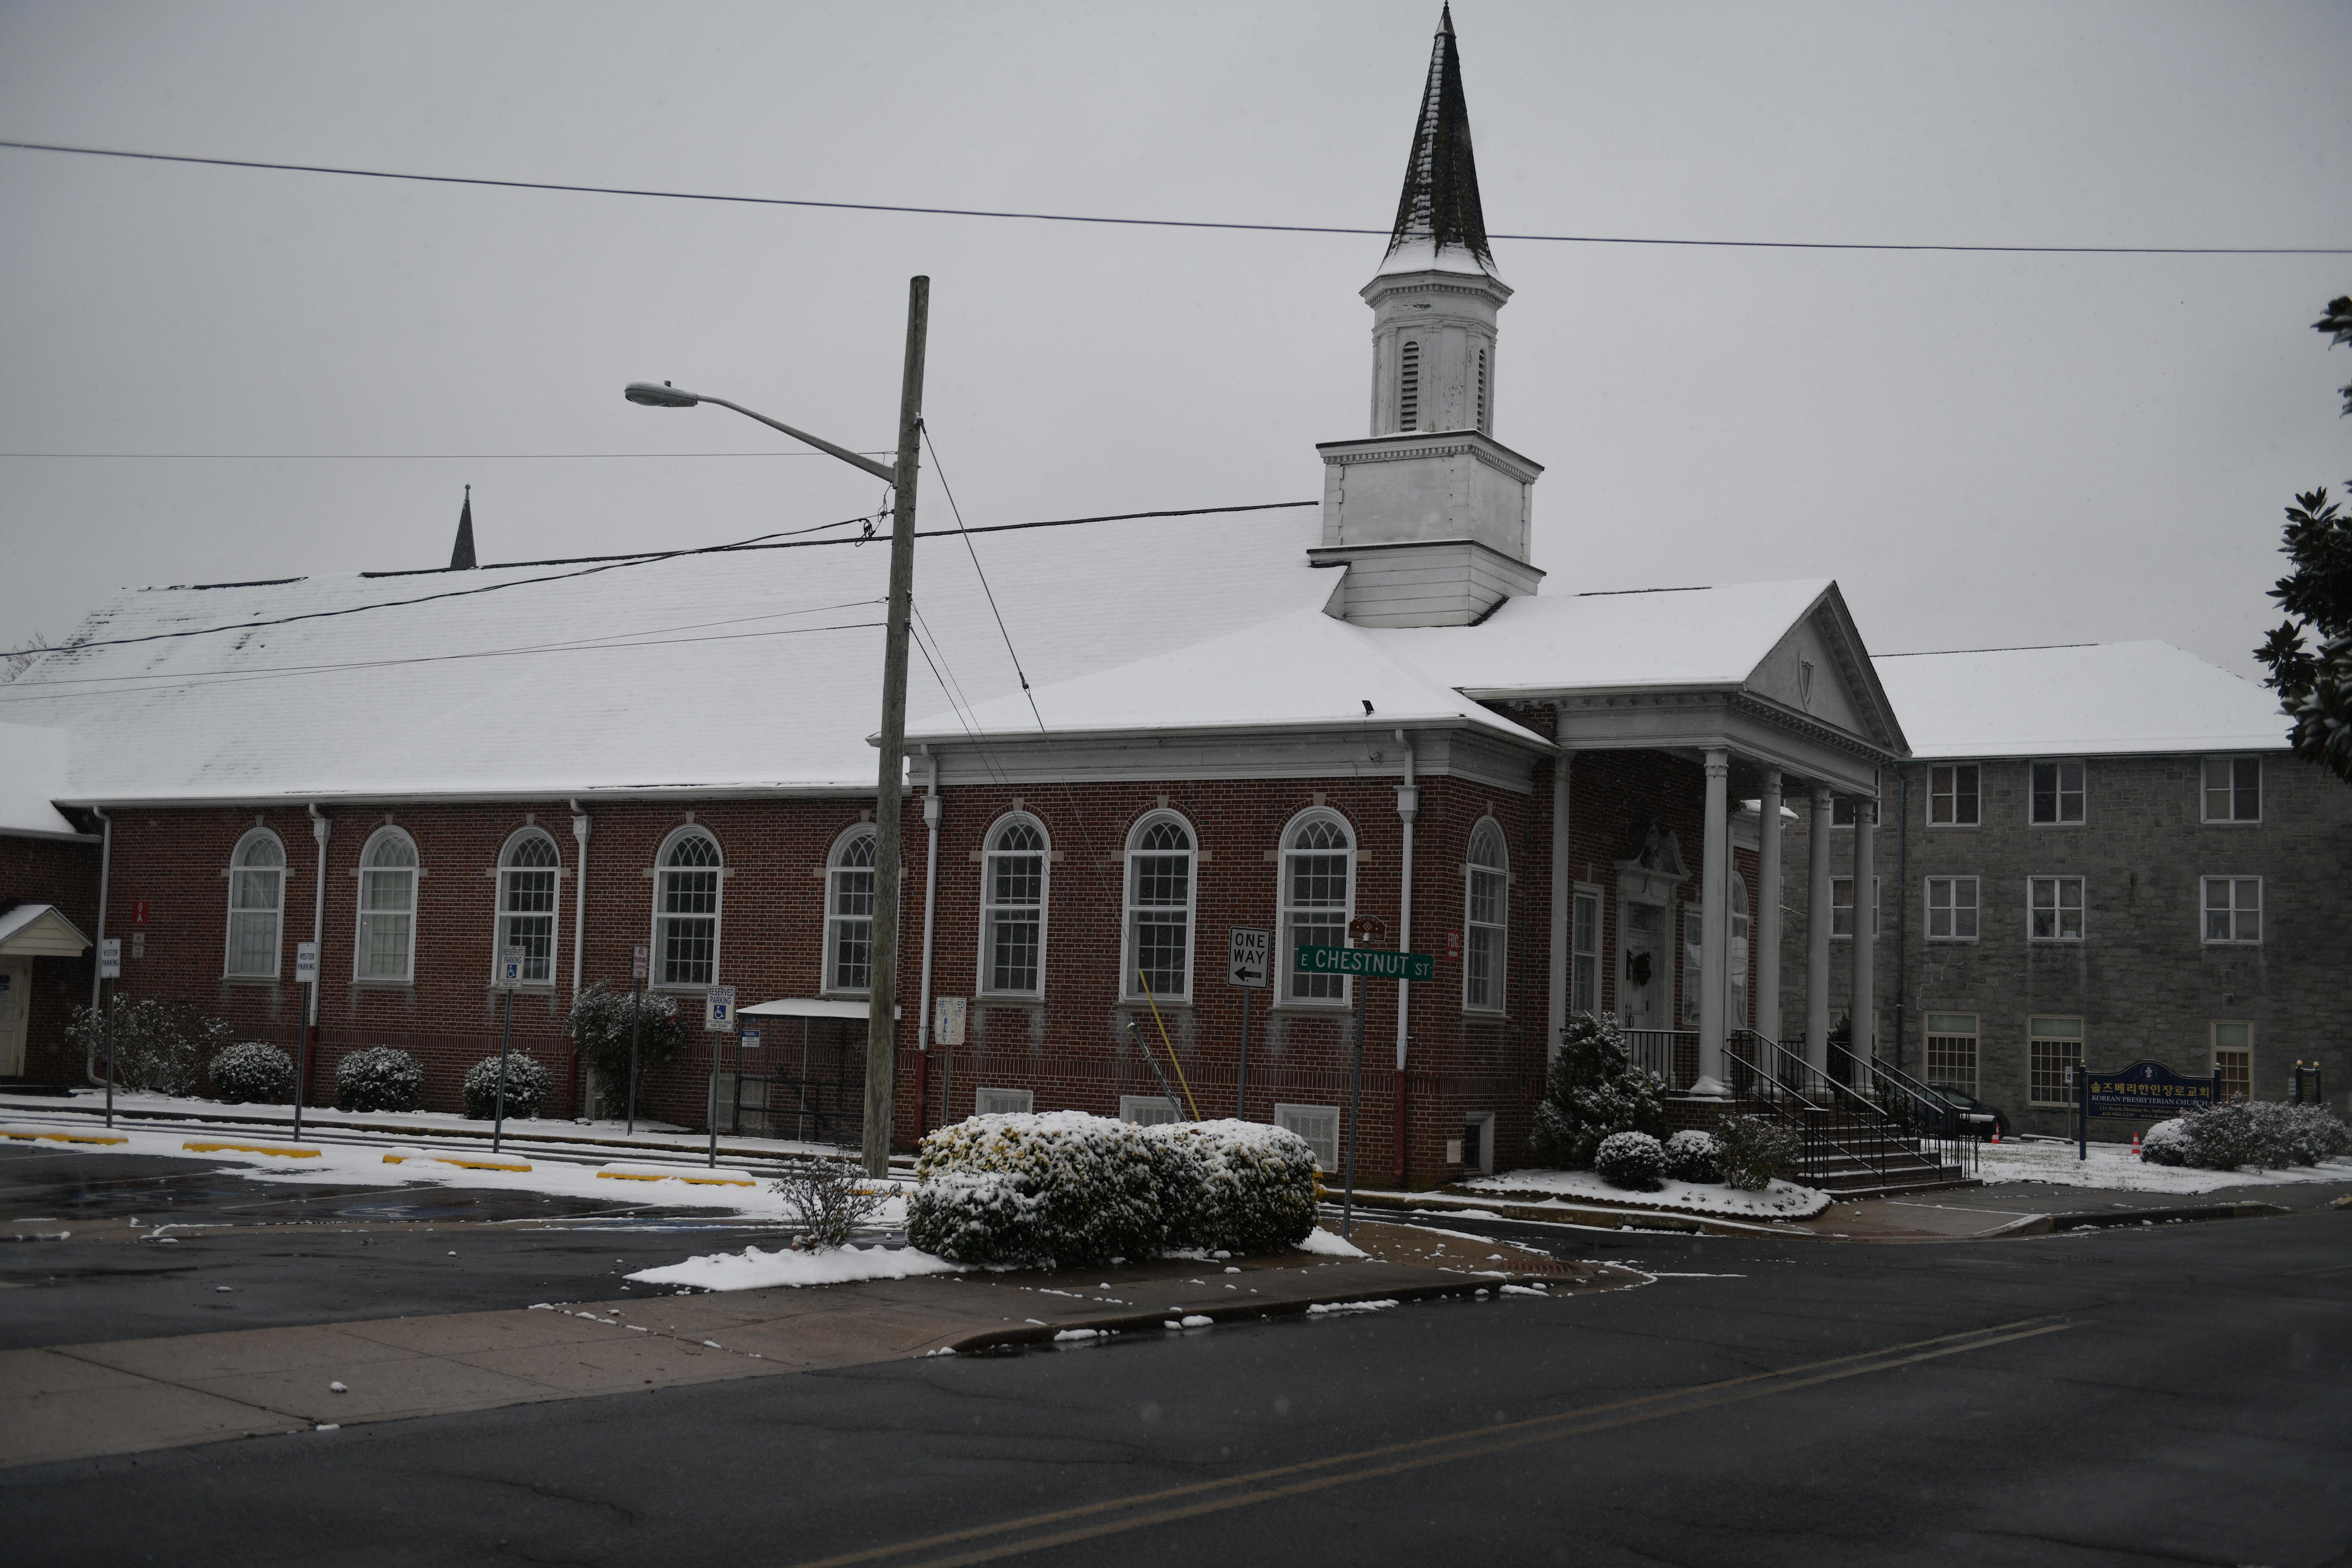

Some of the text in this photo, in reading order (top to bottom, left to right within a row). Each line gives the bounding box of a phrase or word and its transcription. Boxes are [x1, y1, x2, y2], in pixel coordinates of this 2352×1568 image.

[1235, 933, 1265, 948] ONE
[1448, 933, 1458, 948] FDC
[1234, 948, 1265, 964] WAY
[1301, 950, 1429, 976] E CHESTNUT ST
[708, 988, 734, 996] RESERVED
[710, 996, 731, 1004] PARKING
[2090, 1081, 2209, 1098] 솔즈베리한인장로교회
[2123, 1096, 2174, 1104] PRESBYTERIAN
